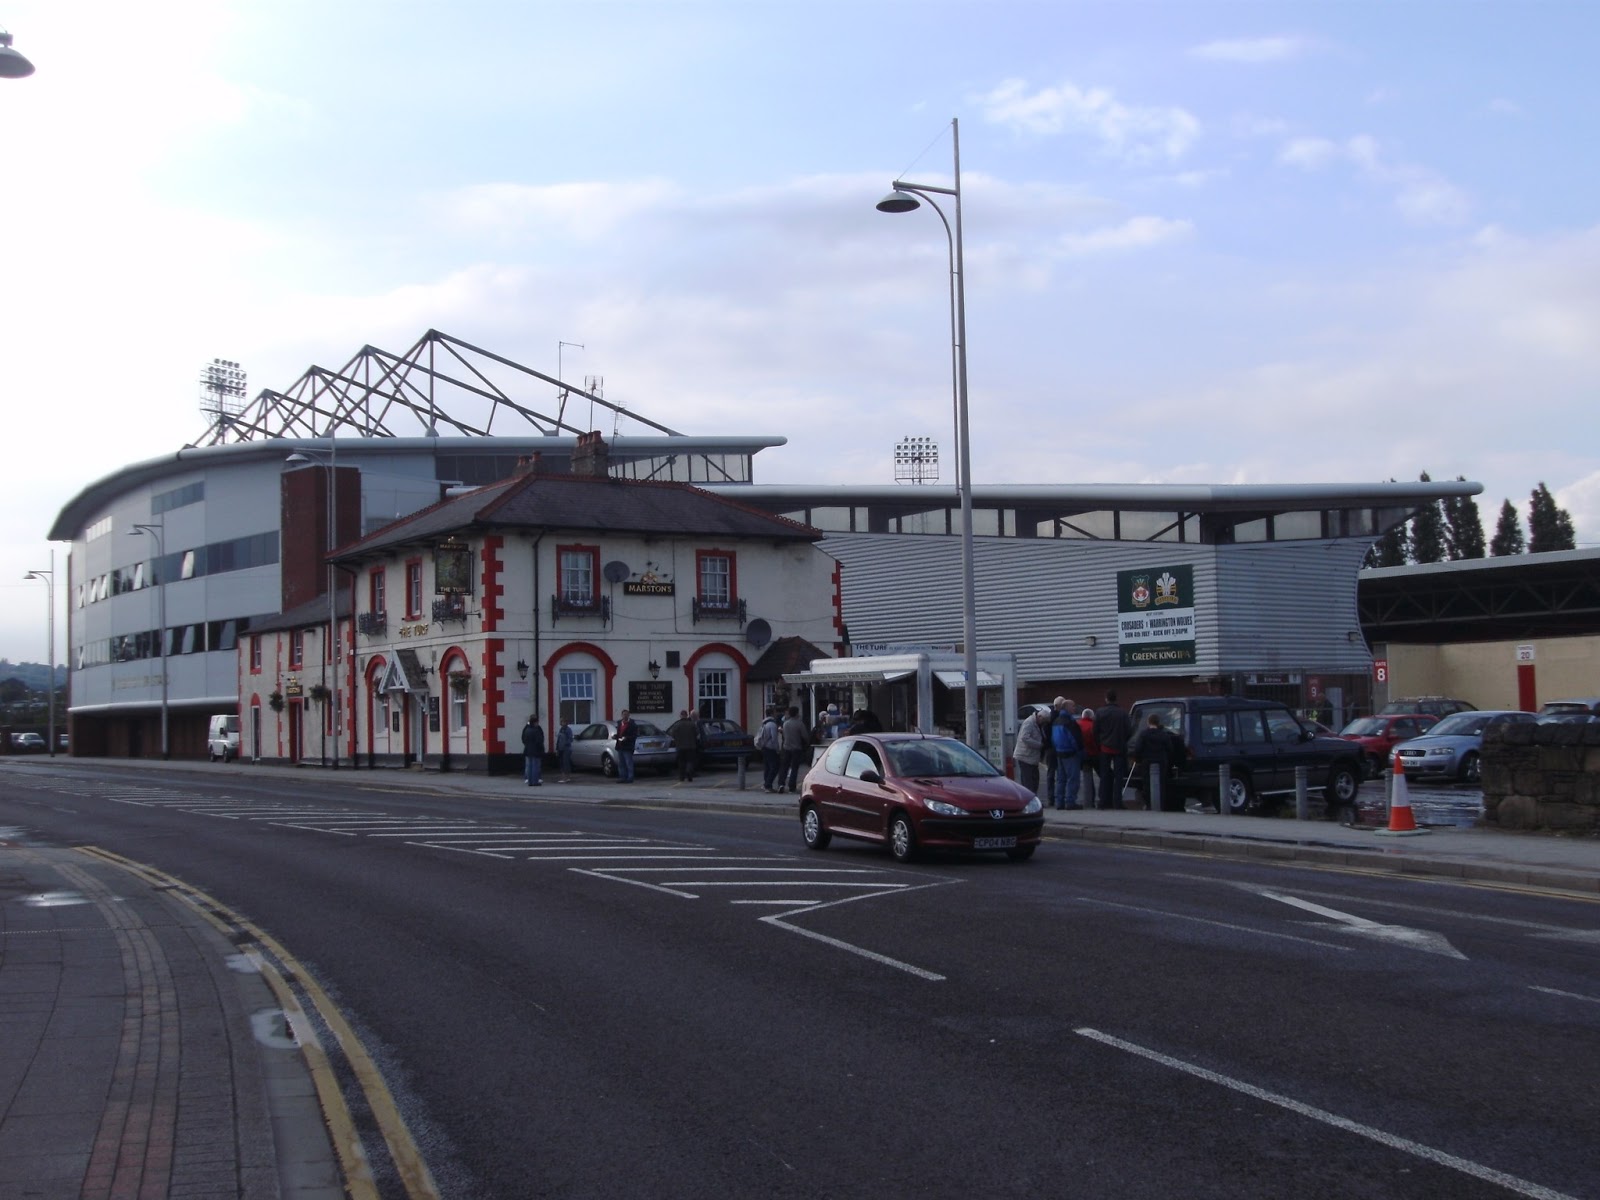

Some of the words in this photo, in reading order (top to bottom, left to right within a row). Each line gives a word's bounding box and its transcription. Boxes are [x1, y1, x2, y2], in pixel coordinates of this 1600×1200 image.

[628, 585, 672, 593] MARSTON'S
[1121, 620, 1144, 631] CRUSADERS
[1150, 617, 1176, 629] WARRINGTON
[1176, 616, 1193, 626] WOLVES
[400, 625, 411, 638] THE
[413, 623, 429, 636] TURF
[1132, 652, 1158, 661] GREENE
[1159, 651, 1177, 660] KING
[1177, 650, 1191, 659] IPA
[1377, 668, 1386, 681] 8
[1311, 686, 1317, 697] 9
[978, 838, 999, 847] CP04
